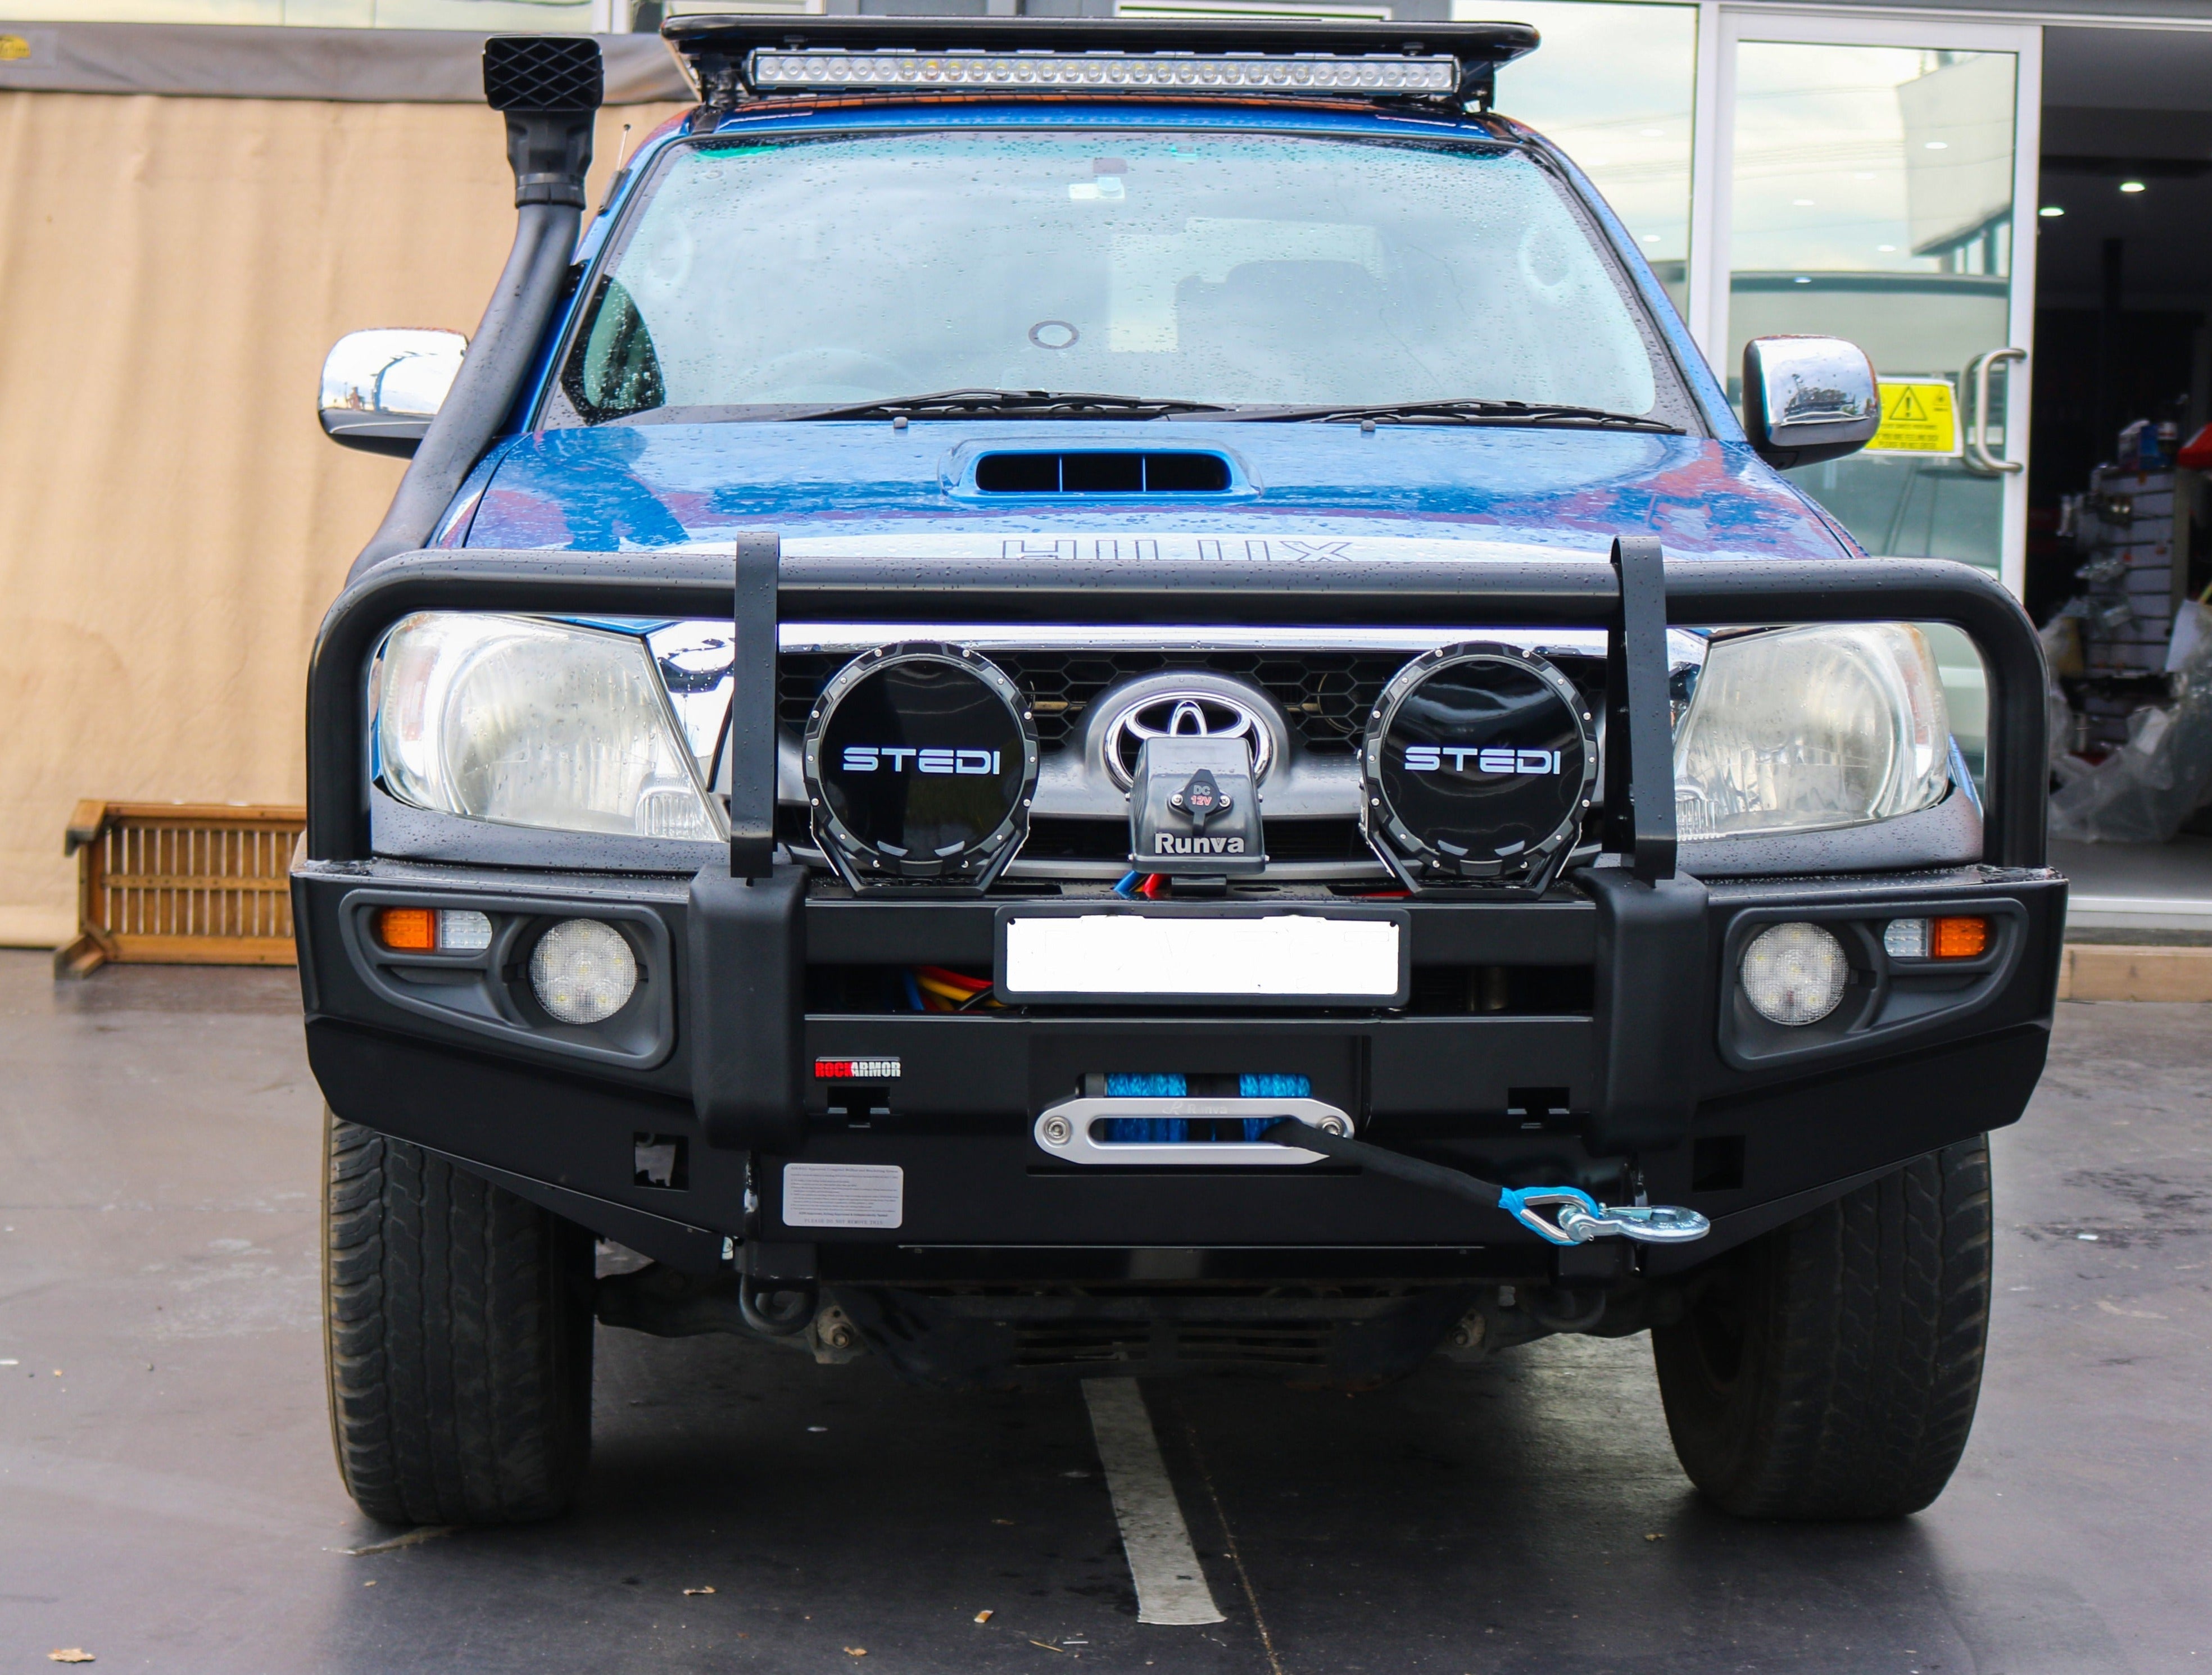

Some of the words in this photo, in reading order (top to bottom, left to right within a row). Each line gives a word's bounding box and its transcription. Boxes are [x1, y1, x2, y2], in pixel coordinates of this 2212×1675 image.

[843, 747, 1000, 775] STEDI
[1404, 746, 1561, 775] STEDI
[1193, 785, 1211, 795] DC
[1190, 795, 1212, 806] 12V
[1154, 833, 1245, 854] Runva
[815, 1061, 901, 1078] ROCKARMOR
